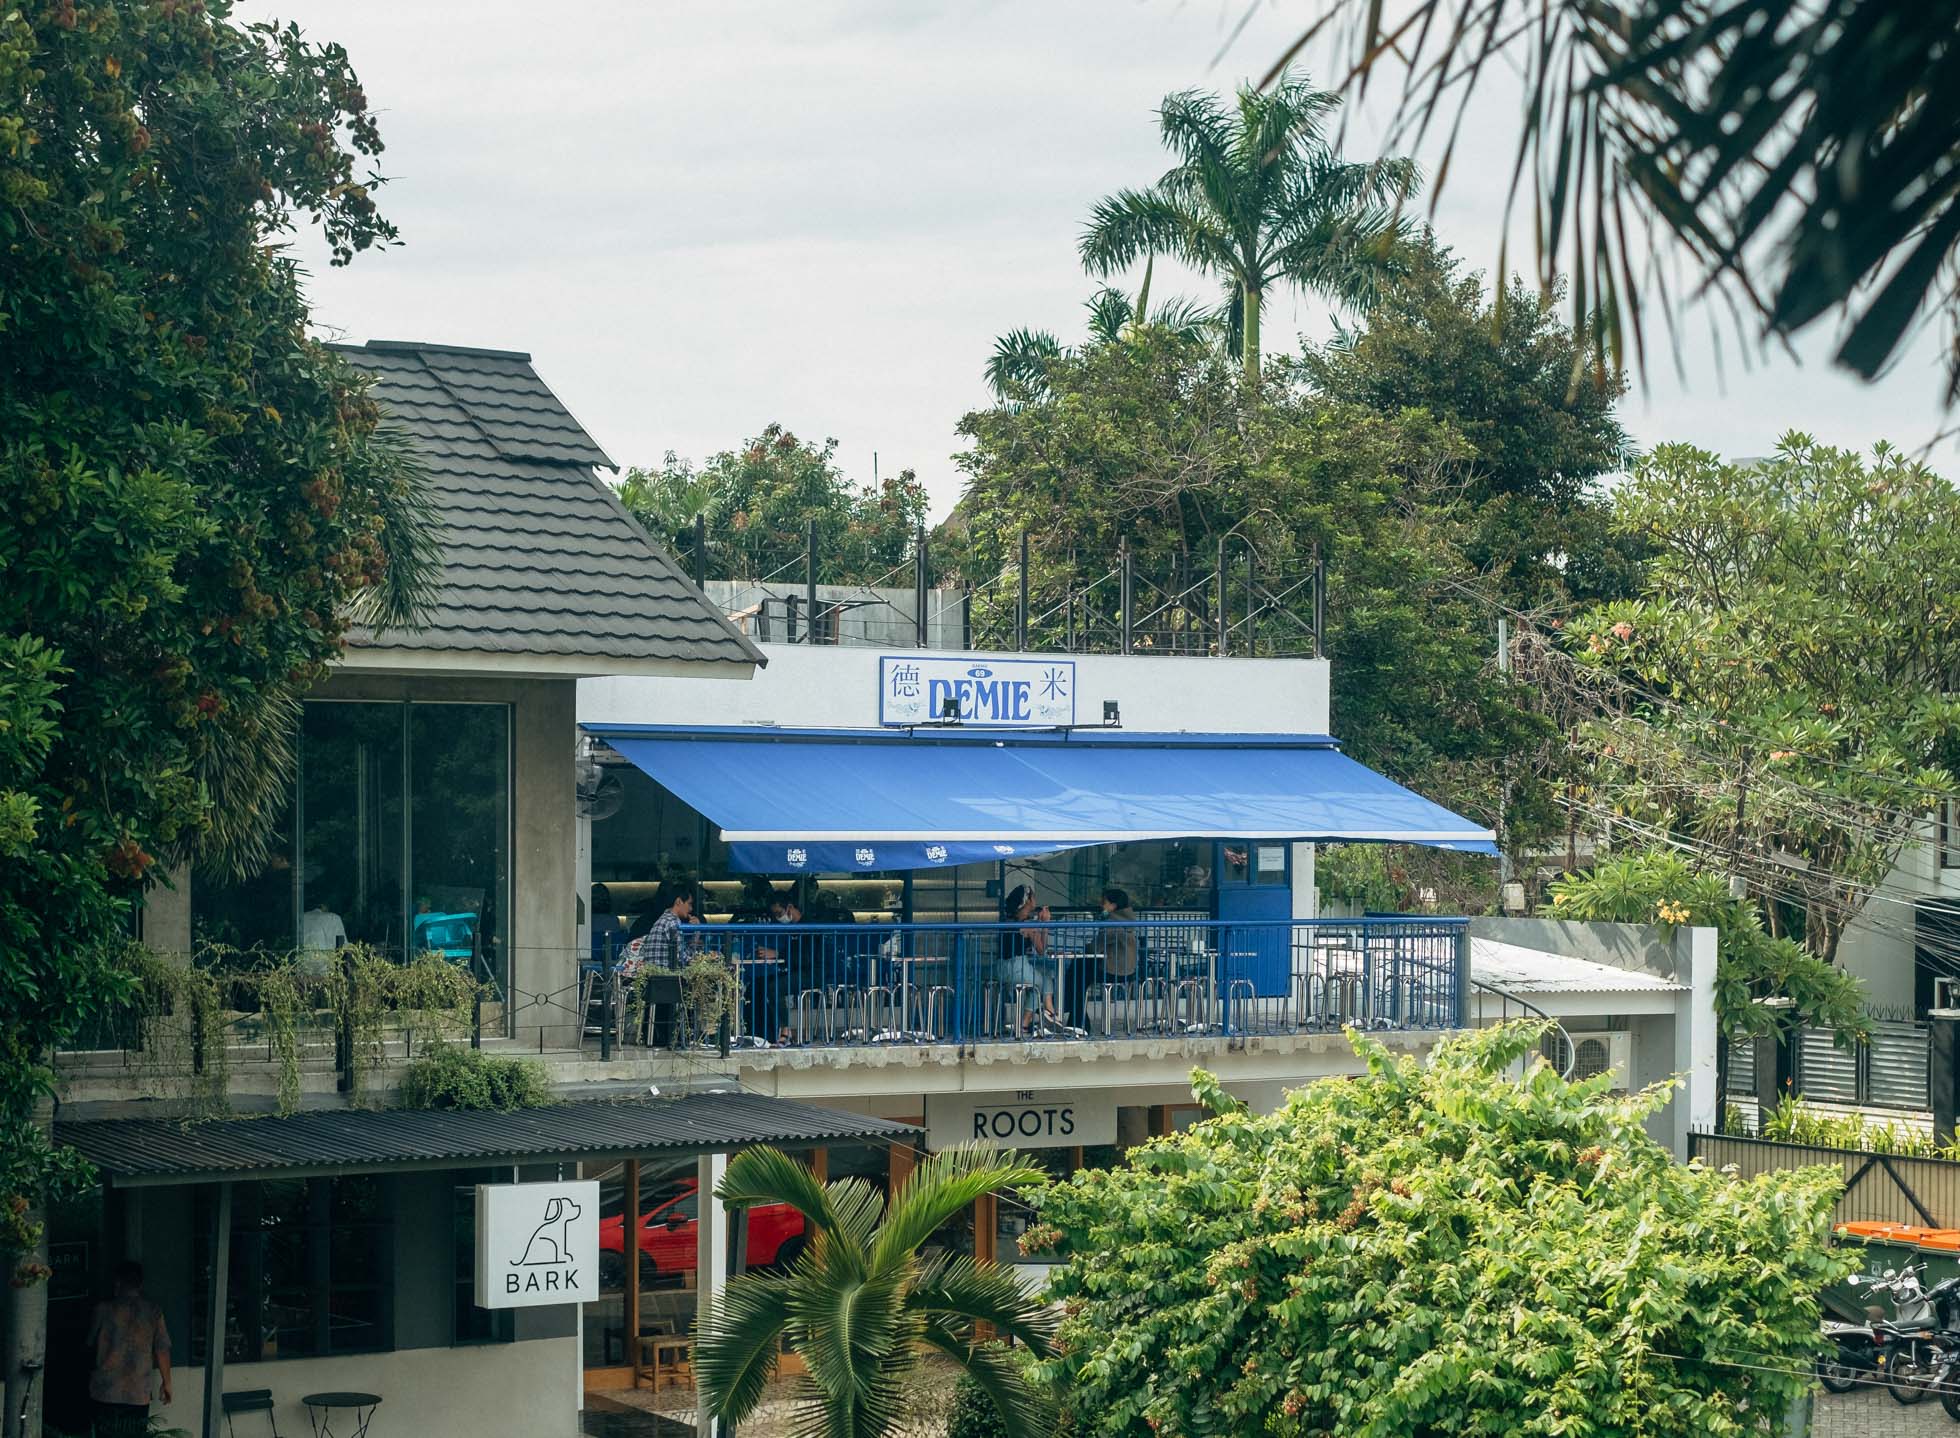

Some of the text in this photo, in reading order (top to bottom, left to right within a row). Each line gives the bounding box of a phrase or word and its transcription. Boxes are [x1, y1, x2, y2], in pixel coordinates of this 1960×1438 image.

[890, 664, 920, 697] 德
[975, 669, 985, 678] 69
[1039, 667, 1067, 701] 米
[928, 679, 1031, 721] DEMIE
[787, 853, 808, 862] DEMIE
[855, 853, 876, 861] DEMIE
[926, 848, 948, 860] DEMIE
[1016, 1090, 1034, 1101] THE
[973, 1108, 1075, 1139] ROOTS
[506, 1268, 579, 1294] BARK
